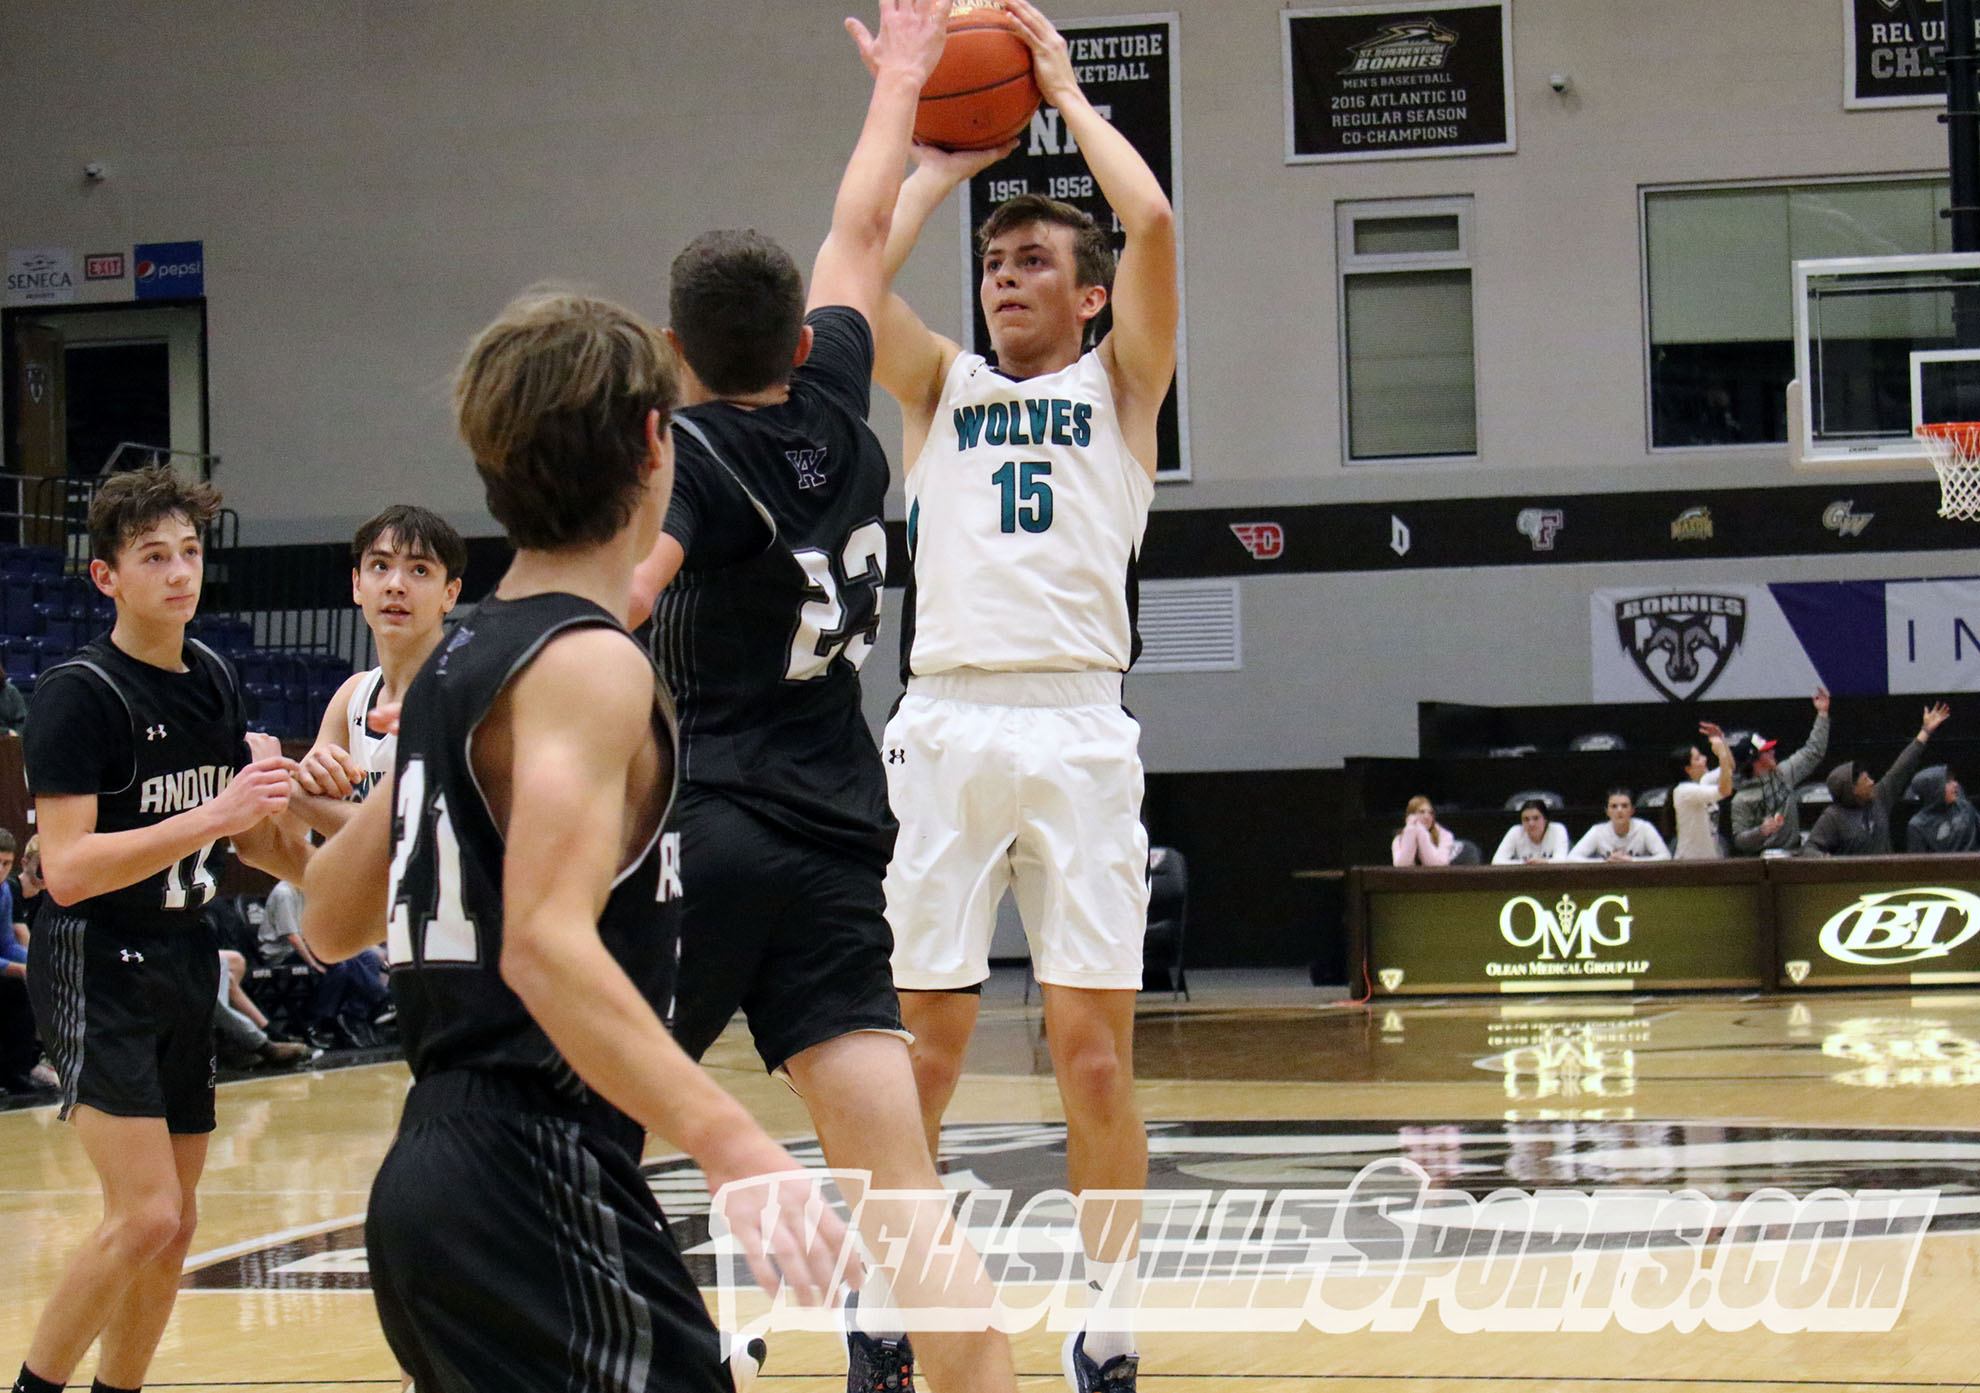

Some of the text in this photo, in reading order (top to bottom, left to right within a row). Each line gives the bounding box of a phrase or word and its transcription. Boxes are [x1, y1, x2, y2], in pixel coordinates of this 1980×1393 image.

[1354, 54, 1443, 71] BONNIES
[1343, 73, 1452, 89] MEN'S BASKETBALL
[1331, 89, 1467, 109] 2016 ATLANTIC 10
[1332, 107, 1467, 127] REGULAR SEASON
[1342, 126, 1458, 145] CO-CHAMPIONS
[989, 176, 1092, 202] 1951 1952
[90, 260, 119, 275] EXIT
[158, 260, 201, 279] pepsi
[8, 272, 72, 290] SENECA
[953, 399, 1092, 451] WOLVES
[992, 461, 1053, 533] 15
[784, 517, 887, 680] 23
[1622, 594, 1744, 619] BONNIES
[1499, 894, 1634, 959] OMG
[1627, 961, 1650, 973] LLP
